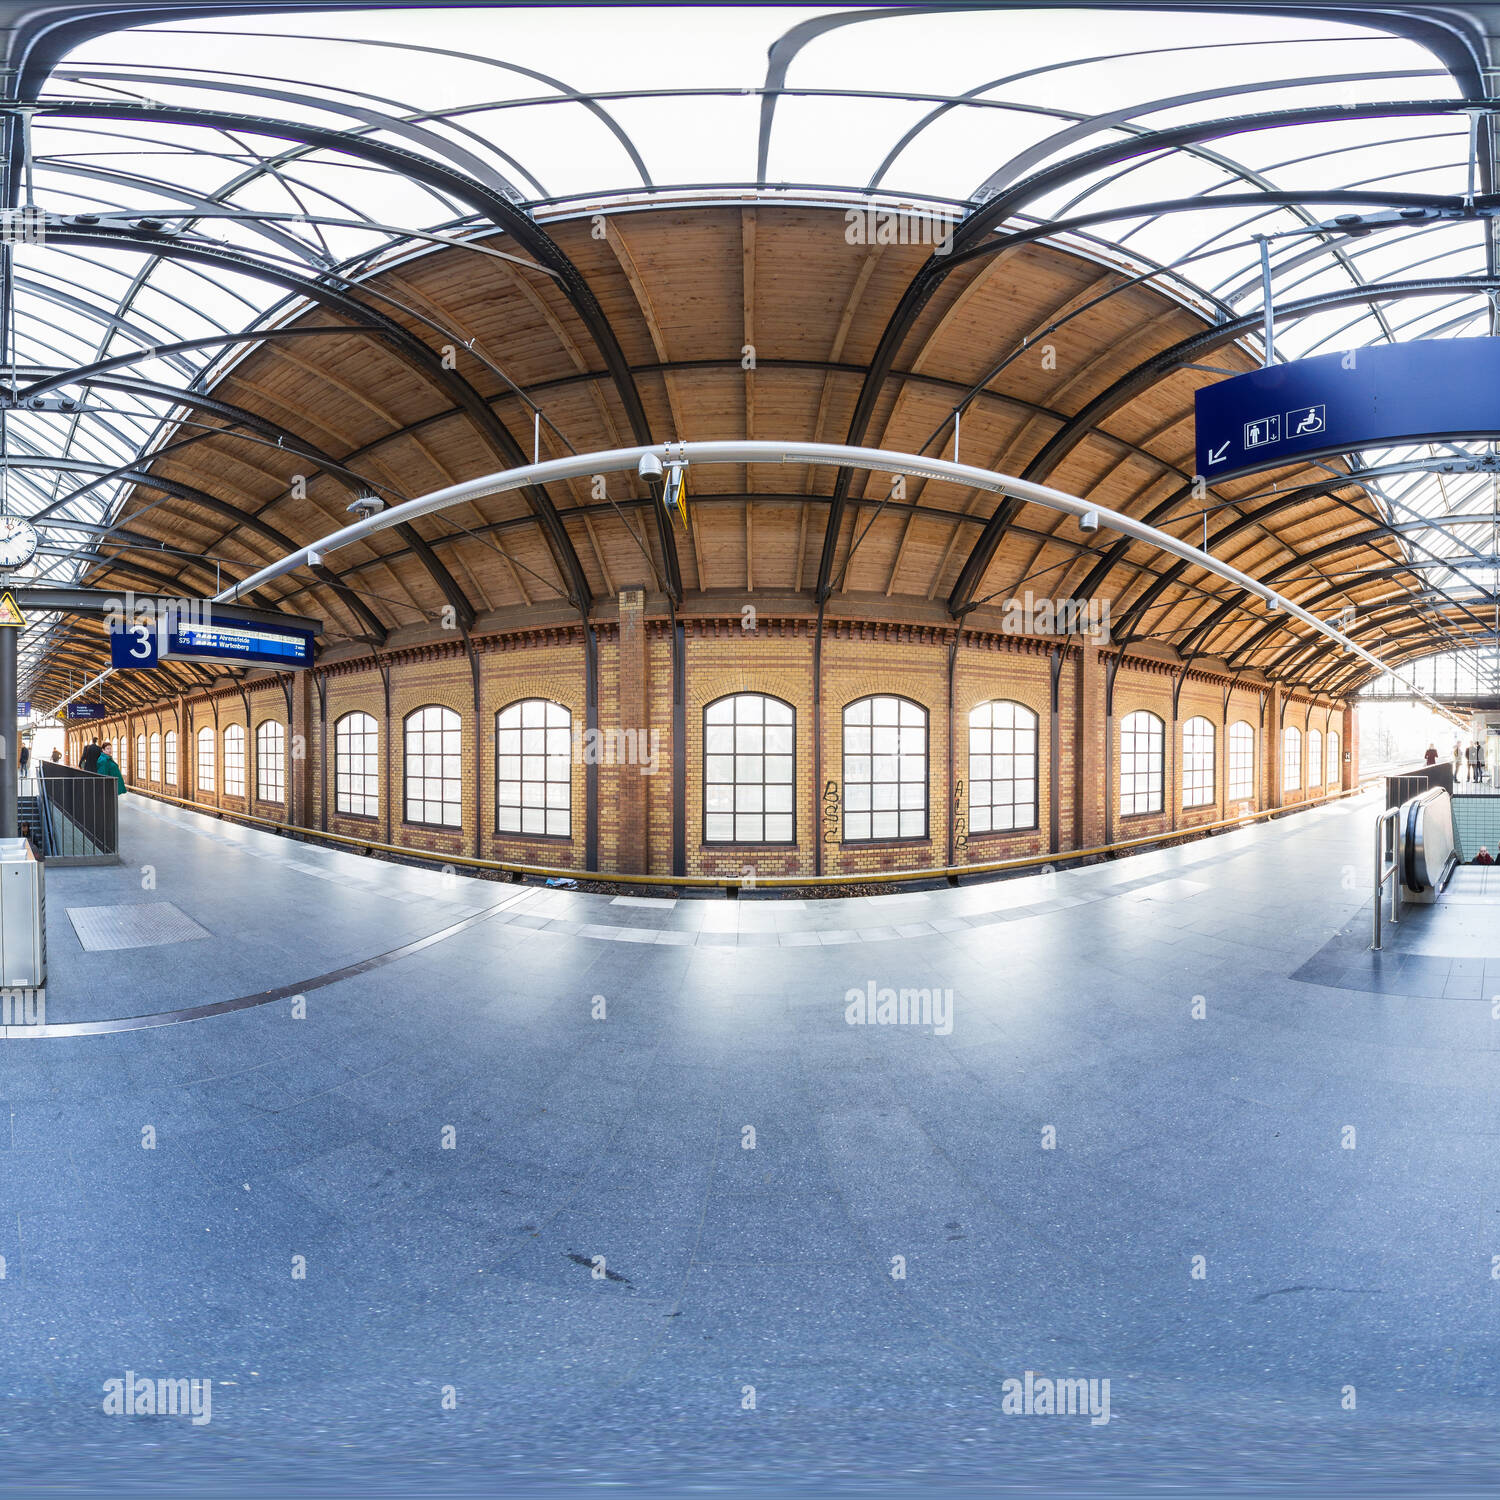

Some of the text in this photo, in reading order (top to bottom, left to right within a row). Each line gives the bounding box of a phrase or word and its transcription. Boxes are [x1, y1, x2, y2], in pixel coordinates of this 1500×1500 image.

[130, 625, 152, 658] 3
[219, 634, 250, 644] Ahrensfelde
[219, 640, 249, 651] Wartenberg
